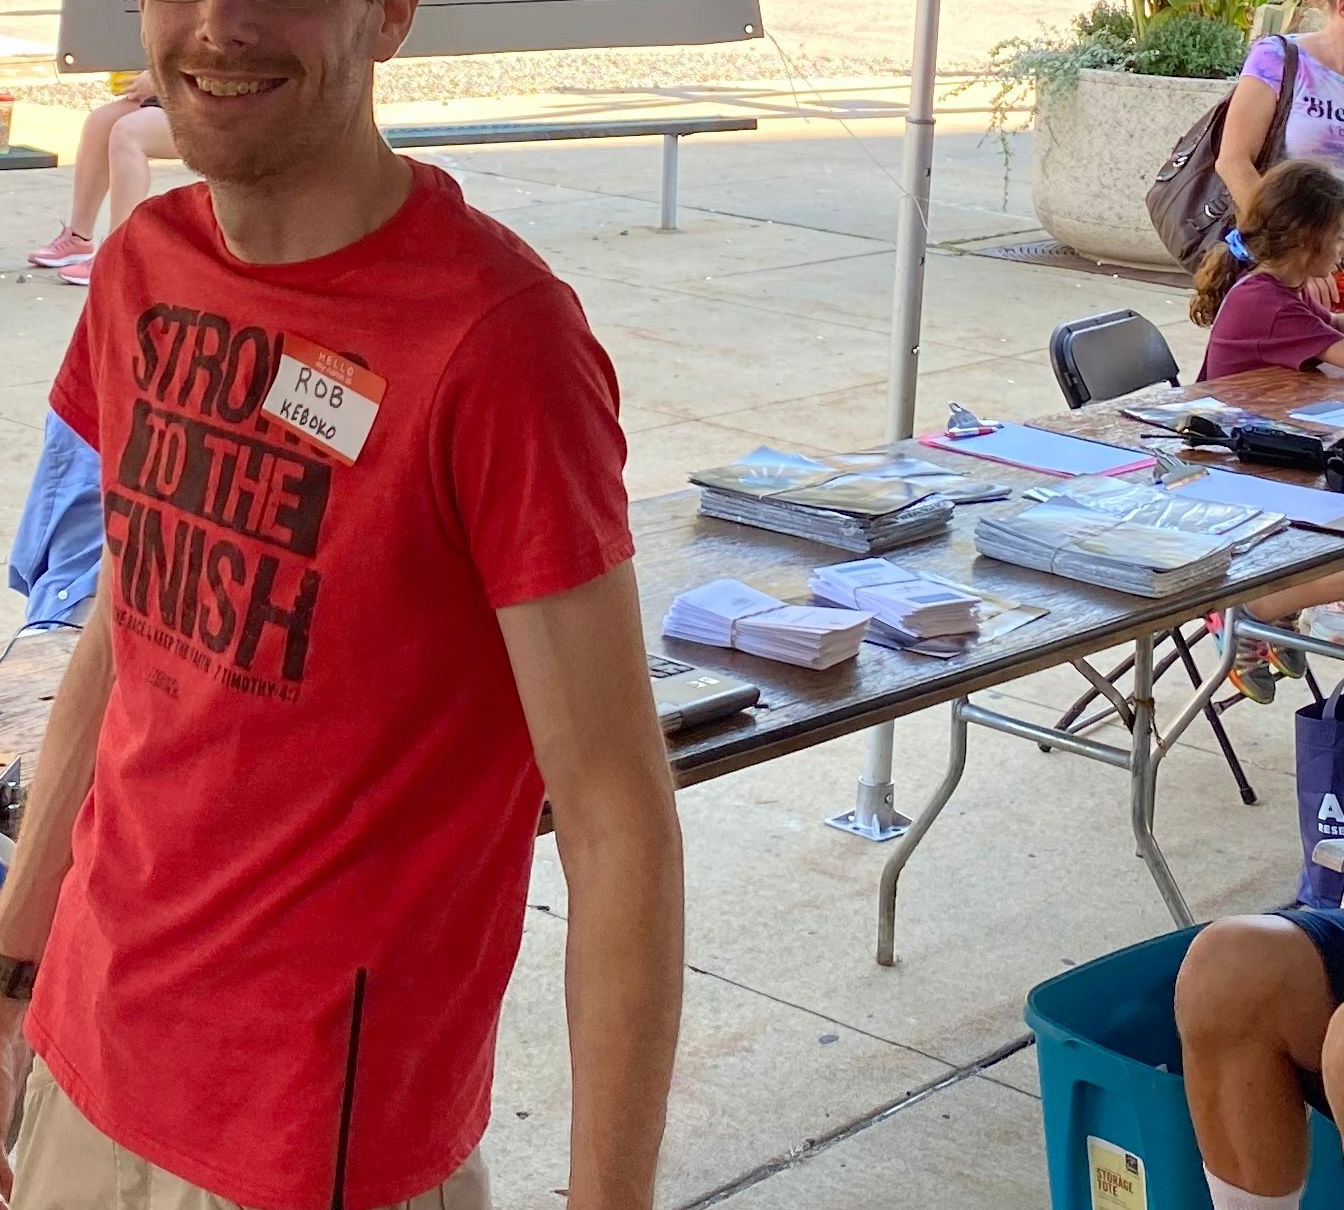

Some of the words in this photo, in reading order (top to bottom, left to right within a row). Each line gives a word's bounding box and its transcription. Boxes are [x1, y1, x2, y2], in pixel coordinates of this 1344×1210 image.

[319, 351, 354, 376] HELLO
[294, 367, 344, 408] ROB
[139, 411, 188, 496] TO
[203, 437, 305, 544] THE
[106, 491, 322, 684] FINISH
[154, 628, 174, 651] KEEP
[221, 666, 275, 698] TIMOTHY
[1096, 1167, 1134, 1195] STORAGE
[1097, 1178, 1119, 1198] TOTE
